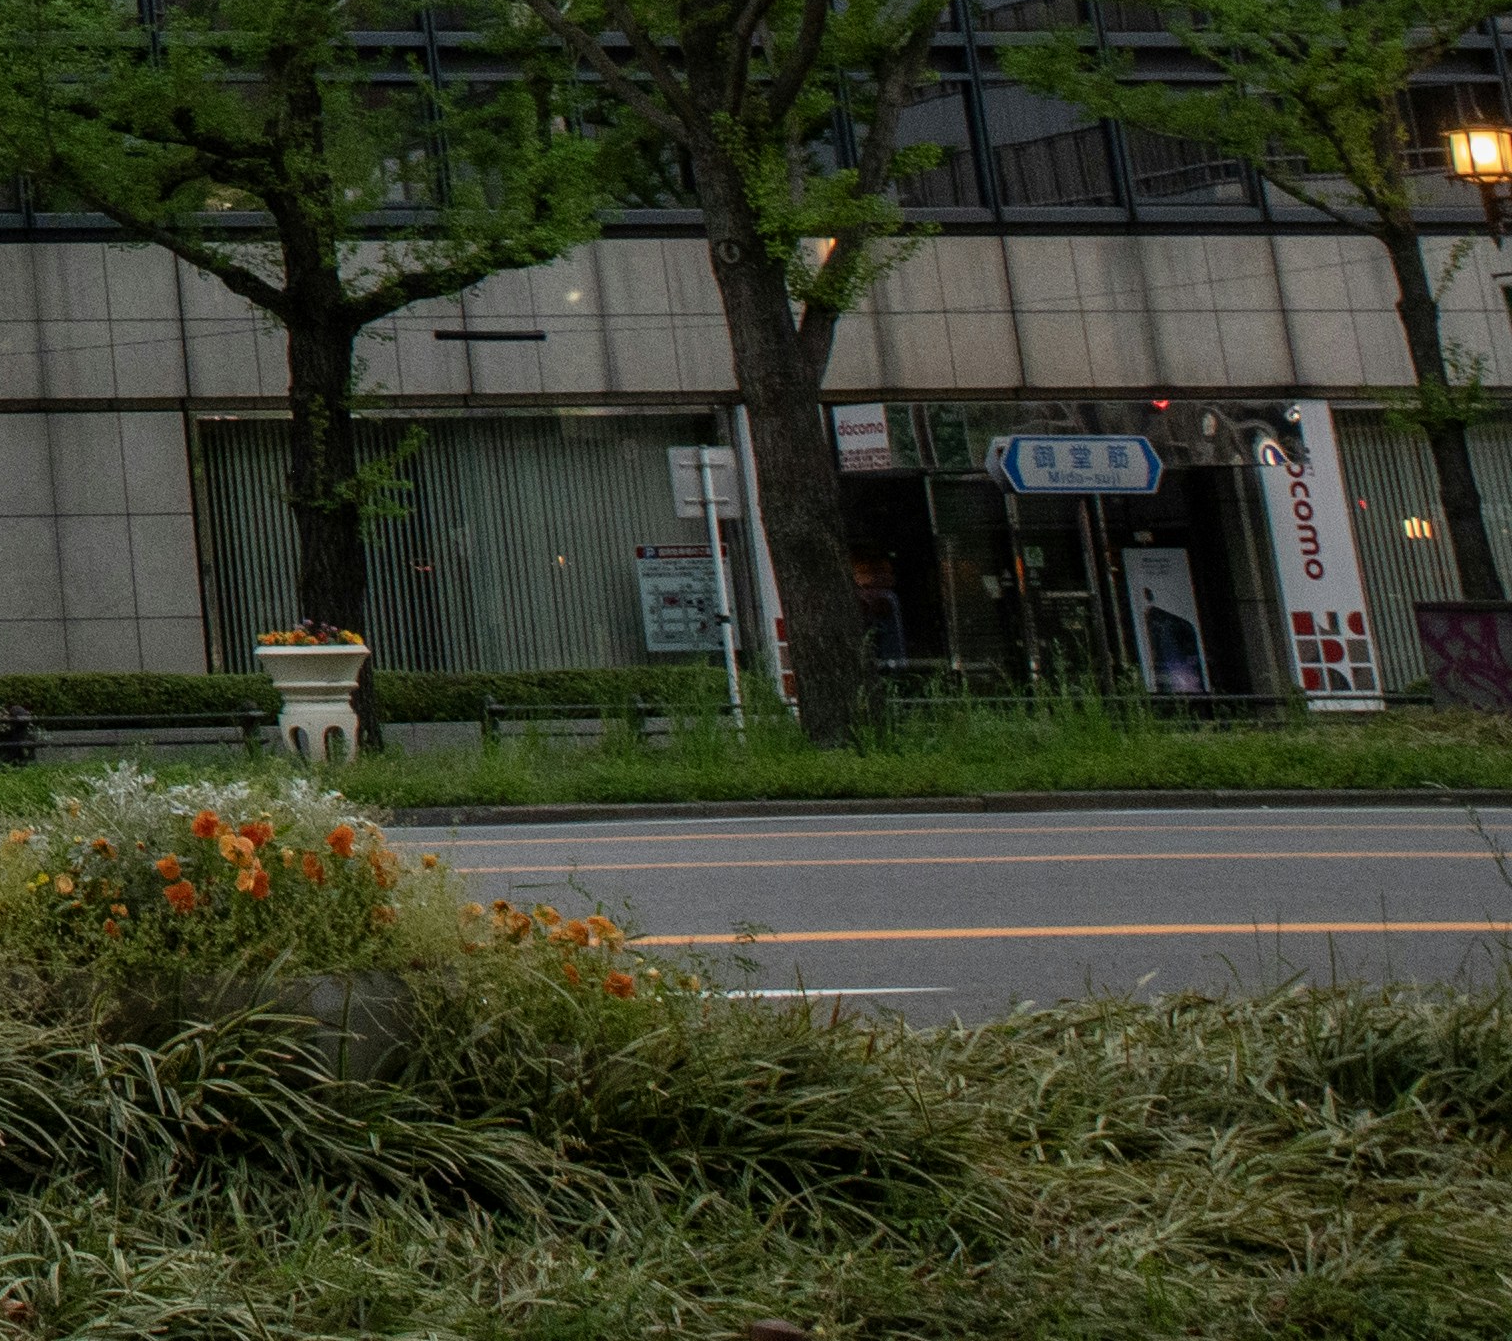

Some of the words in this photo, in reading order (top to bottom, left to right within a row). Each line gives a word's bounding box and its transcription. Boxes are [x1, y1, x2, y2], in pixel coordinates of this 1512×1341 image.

[837, 421, 884, 437] docomo
[1032, 444, 1130, 469] 御堂筋
[1284, 462, 1324, 581] ocomo
